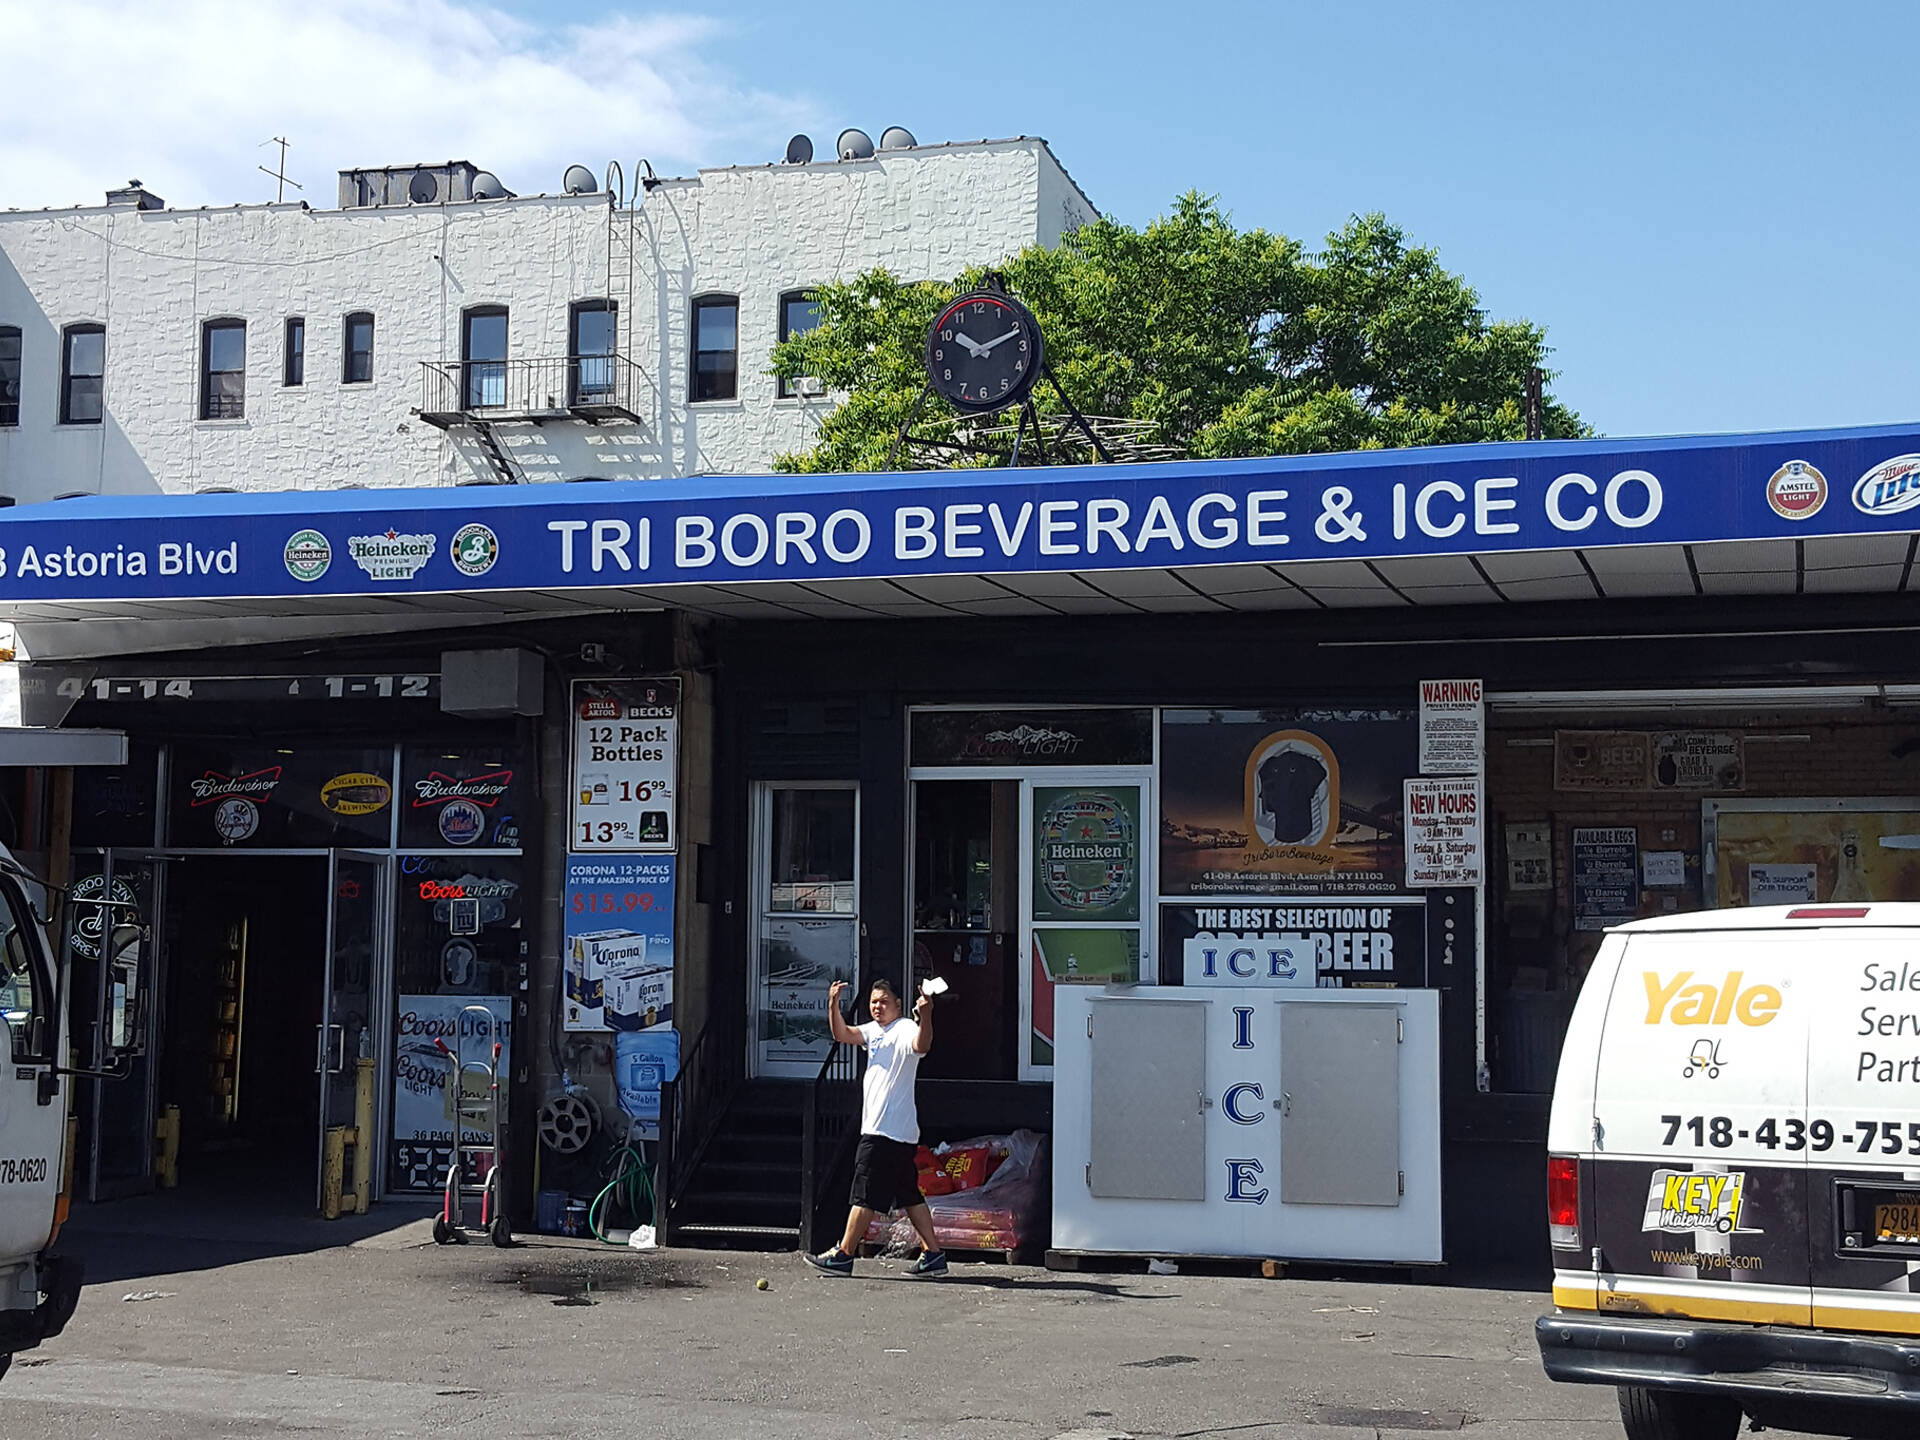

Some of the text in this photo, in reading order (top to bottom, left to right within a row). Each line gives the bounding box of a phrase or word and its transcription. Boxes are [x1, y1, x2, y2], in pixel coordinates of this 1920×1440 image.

[972, 302, 985, 314] 12
[994, 308, 1001, 318] 1
[953, 312, 965, 324] 11
[1011, 321, 1020, 332] 2
[940, 329, 953, 341] 10
[1018, 341, 1027, 351] 3
[935, 349, 944, 361] 9
[1014, 360, 1023, 372] 4
[944, 369, 952, 380] 8
[959, 382, 968, 394] 7
[1000, 378, 1009, 390] 5
[979, 386, 988, 399] 6
[1779, 482, 1815, 492] AMSTEL
[1783, 493, 1811, 501] LIGHT
[547, 469, 1663, 572] TRI BORO BEVERAGE & ICE CO
[288, 550, 328, 559] Heineken
[356, 543, 429, 557] Heineken
[17, 544, 147, 578] Astoria
[159, 541, 238, 575] Blvd
[373, 566, 413, 578] LIGHT
[1423, 682, 1480, 702] WARNING
[630, 706, 673, 717] BECK'S
[590, 726, 668, 743] 12 Pack
[591, 745, 663, 762] Bottles
[1023, 738, 1083, 754] LIGHT
[191, 778, 279, 797] Budweiser
[415, 780, 508, 798] Budweiser
[1410, 792, 1476, 814] NEW HOURS
[1577, 831, 1633, 844] AVAILABLE KEGS
[1052, 844, 1122, 859] Heineken
[1414, 843, 1434, 855] Friday
[1446, 842, 1476, 854] Saturday
[570, 865, 670, 876] CORONA 12-PACKS
[1232, 872, 1268, 880] Astoria
[1337, 872, 1353, 880] NY
[1355, 872, 1384, 880] 11103
[570, 877, 579, 885] AT
[597, 877, 635, 885] AMAZING
[636, 876, 658, 884] PRICE
[659, 876, 670, 884] OF
[420, 880, 510, 899] Coors LIGHT
[573, 892, 654, 915] $15.99
[1195, 909, 1392, 929] THE BEST SELECTION OF
[596, 944, 640, 967] Corona
[1316, 931, 1394, 970] BEER
[1202, 948, 1298, 979] ICE
[1642, 971, 1782, 1026] Yale
[399, 1011, 456, 1037] Coors
[397, 1055, 447, 1089] Coors
[405, 1080, 433, 1096] LIGHT
[413, 1130, 427, 1141] 36
[462, 1131, 489, 1142] CANS
[0, 1158, 48, 1183] 78-0620
[1662, 1175, 1728, 1214] KEY
[1660, 1209, 1718, 1228] Material
[1881, 1206, 1919, 1231] 2984
[1651, 1247, 1763, 1270] www.keyyale.com
